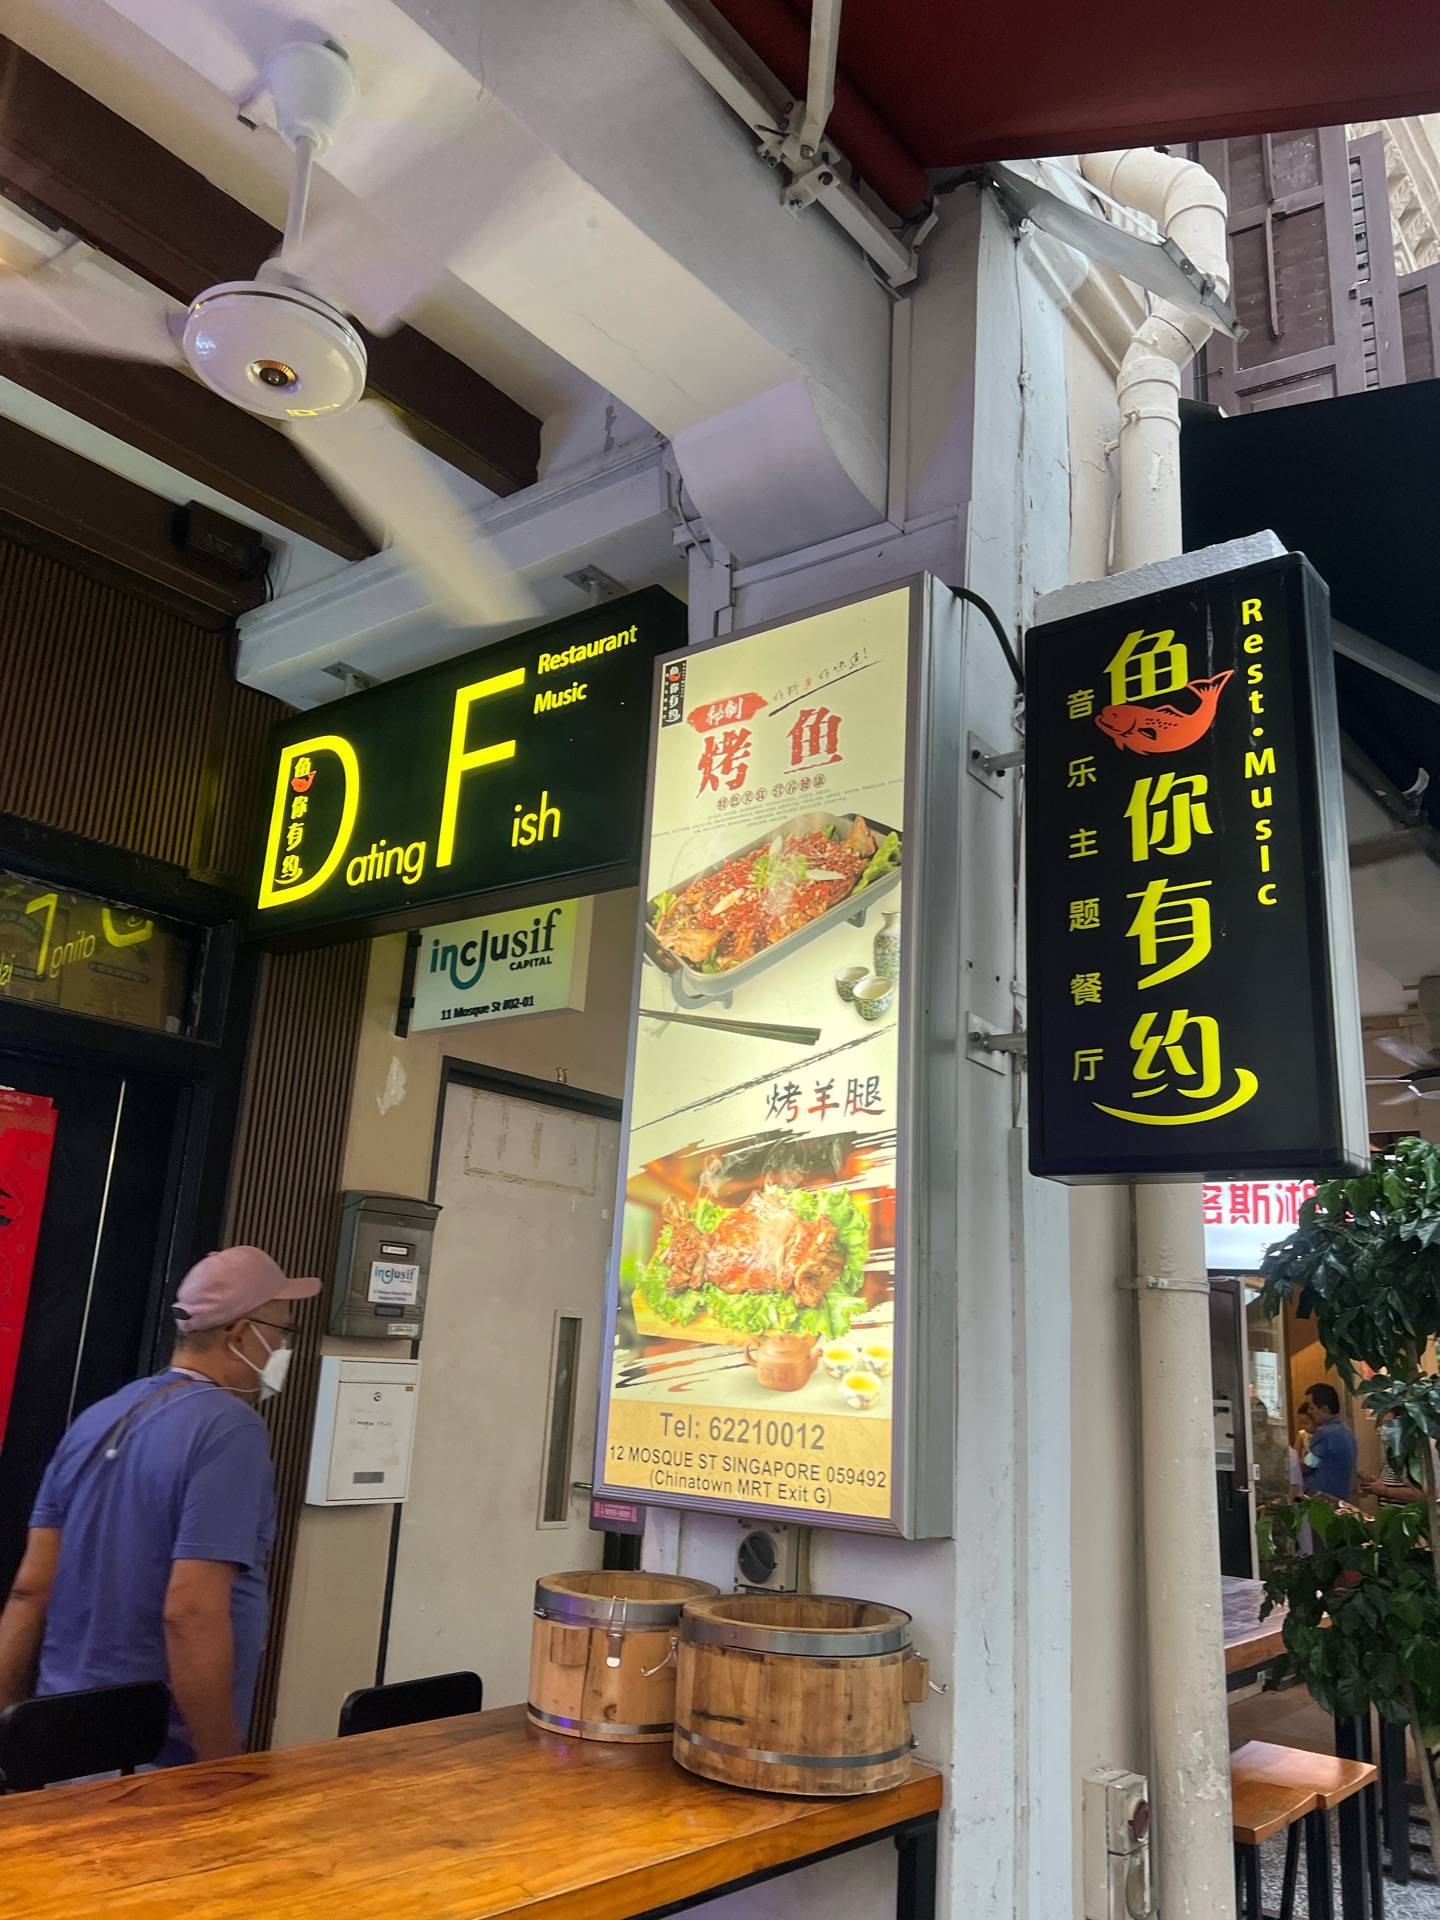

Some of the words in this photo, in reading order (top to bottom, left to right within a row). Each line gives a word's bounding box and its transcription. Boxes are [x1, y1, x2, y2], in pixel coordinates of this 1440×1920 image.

[538, 625, 638, 674] Restaurant
[533, 682, 588, 714] Music
[696, 706, 843, 799] 烤鱼
[1066, 688, 1104, 1082] 音乐主题餐厅
[1103, 629, 1222, 1099] 鱼你有约
[430, 908, 562, 990] inclusif
[509, 955, 552, 971] CAPITAL
[440, 1009, 452, 1020] 11
[453, 1005, 490, 1017] Mosque
[491, 1001, 501, 1012] St
[765, 1076, 886, 1123] 烤羊腿
[660, 1411, 700, 1439] Tel:
[709, 1416, 825, 1450] 62210012
[610, 1445, 624, 1460] 12
[628, 1446, 693, 1467] MOSQUE
[698, 1453, 719, 1470] ST
[722, 1455, 821, 1481] SINGAPORE
[826, 1466, 886, 1488] 059492
[650, 1469, 732, 1494] (Chinatown
[737, 1478, 772, 1497] MRT
[778, 1482, 808, 1502] Exit
[813, 1487, 832, 1509] G)
